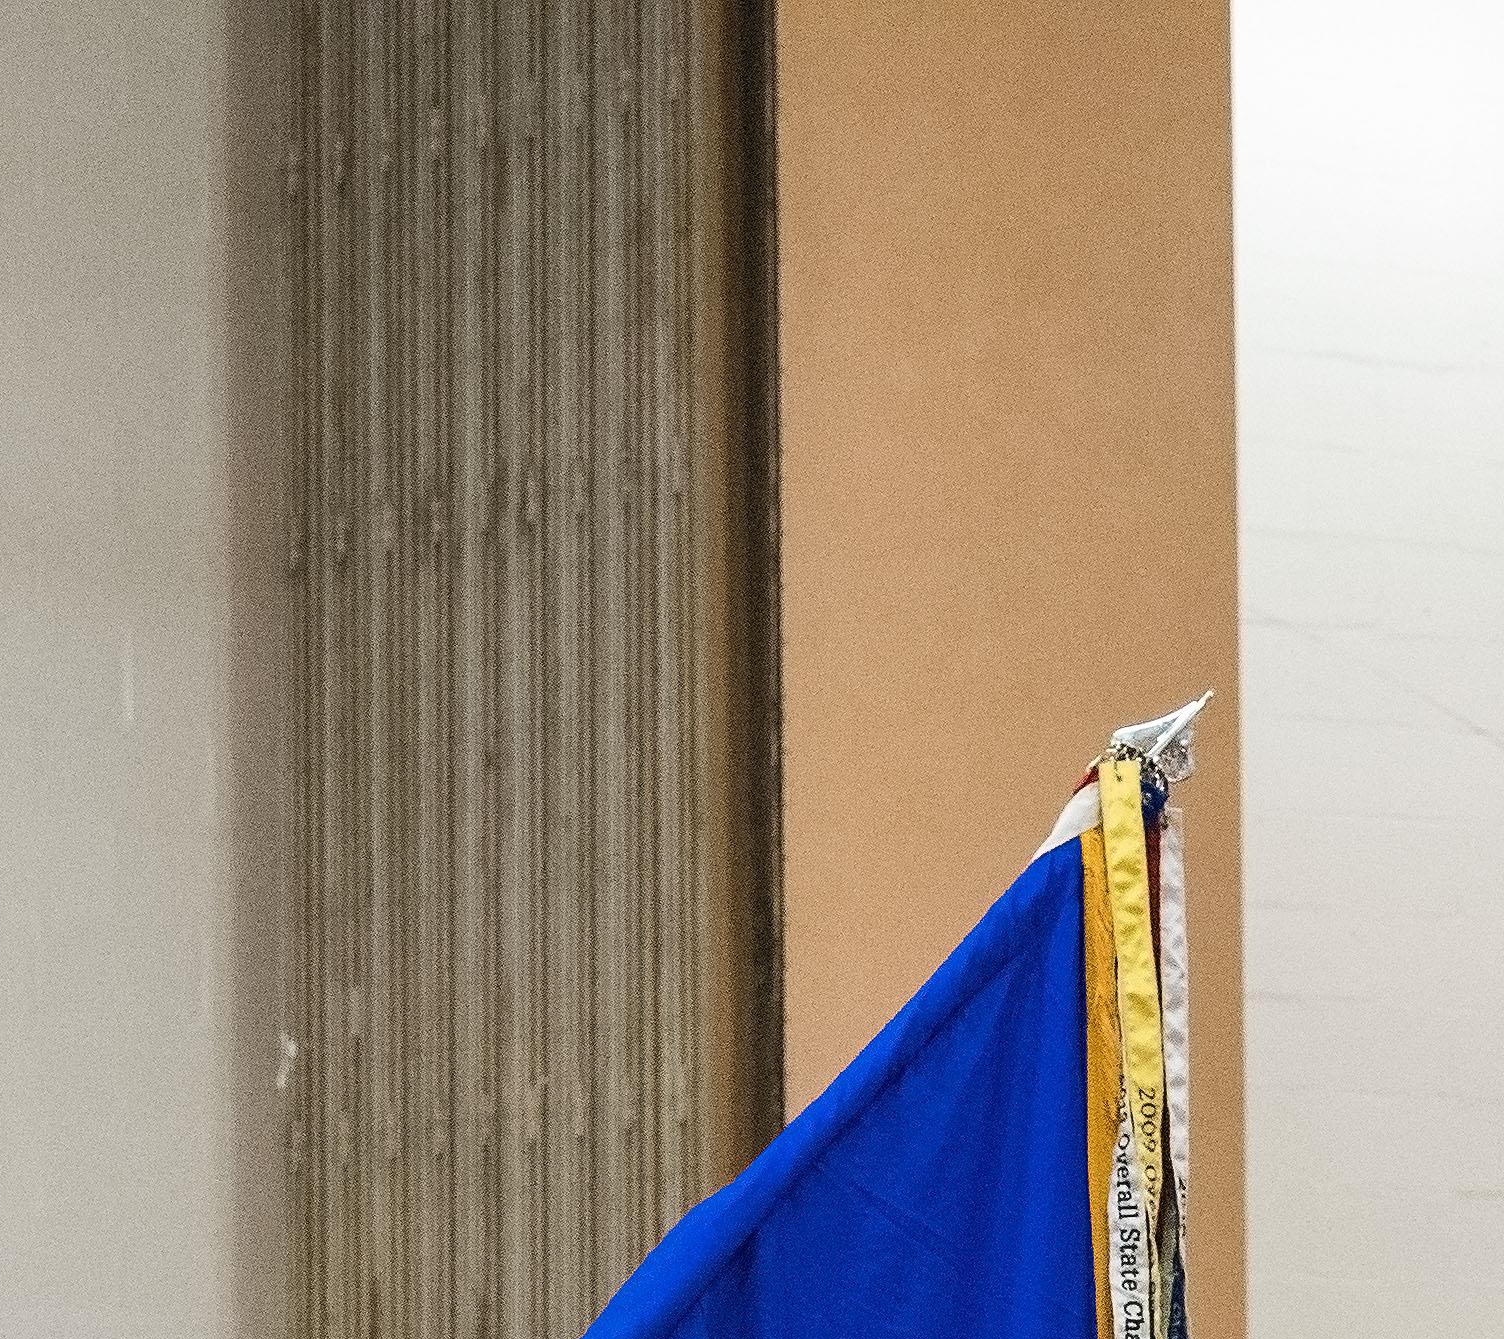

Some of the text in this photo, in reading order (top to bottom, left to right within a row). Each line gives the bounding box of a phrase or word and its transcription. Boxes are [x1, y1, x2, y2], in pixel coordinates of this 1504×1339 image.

[1138, 1086, 1157, 1153] 2009
[1116, 1133, 1139, 1219] Overall
[1119, 1229, 1141, 1291] State
